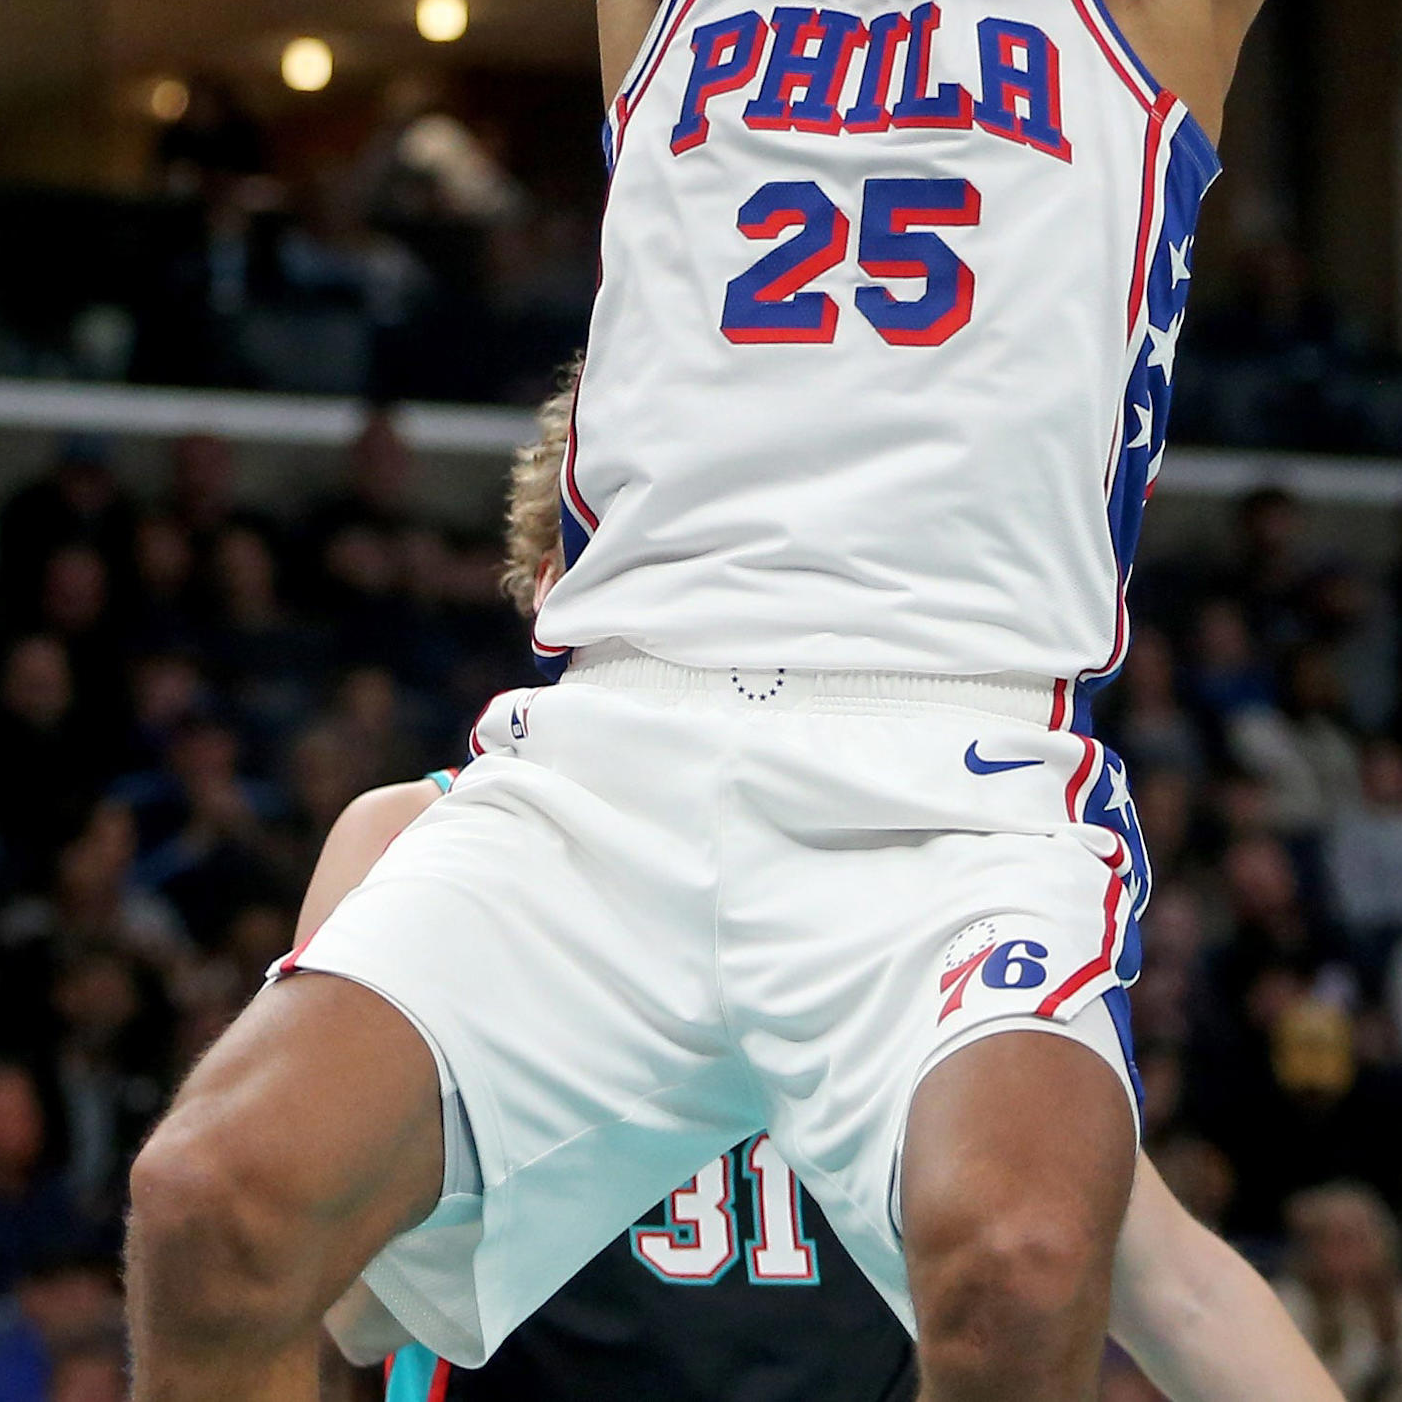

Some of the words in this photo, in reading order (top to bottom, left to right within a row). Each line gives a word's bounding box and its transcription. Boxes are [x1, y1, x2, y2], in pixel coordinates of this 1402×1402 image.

[670, 2, 1072, 164] PHILA
[721, 179, 980, 346] 25
[937, 939, 1048, 1027] 76
[629, 1129, 820, 1285] 31
